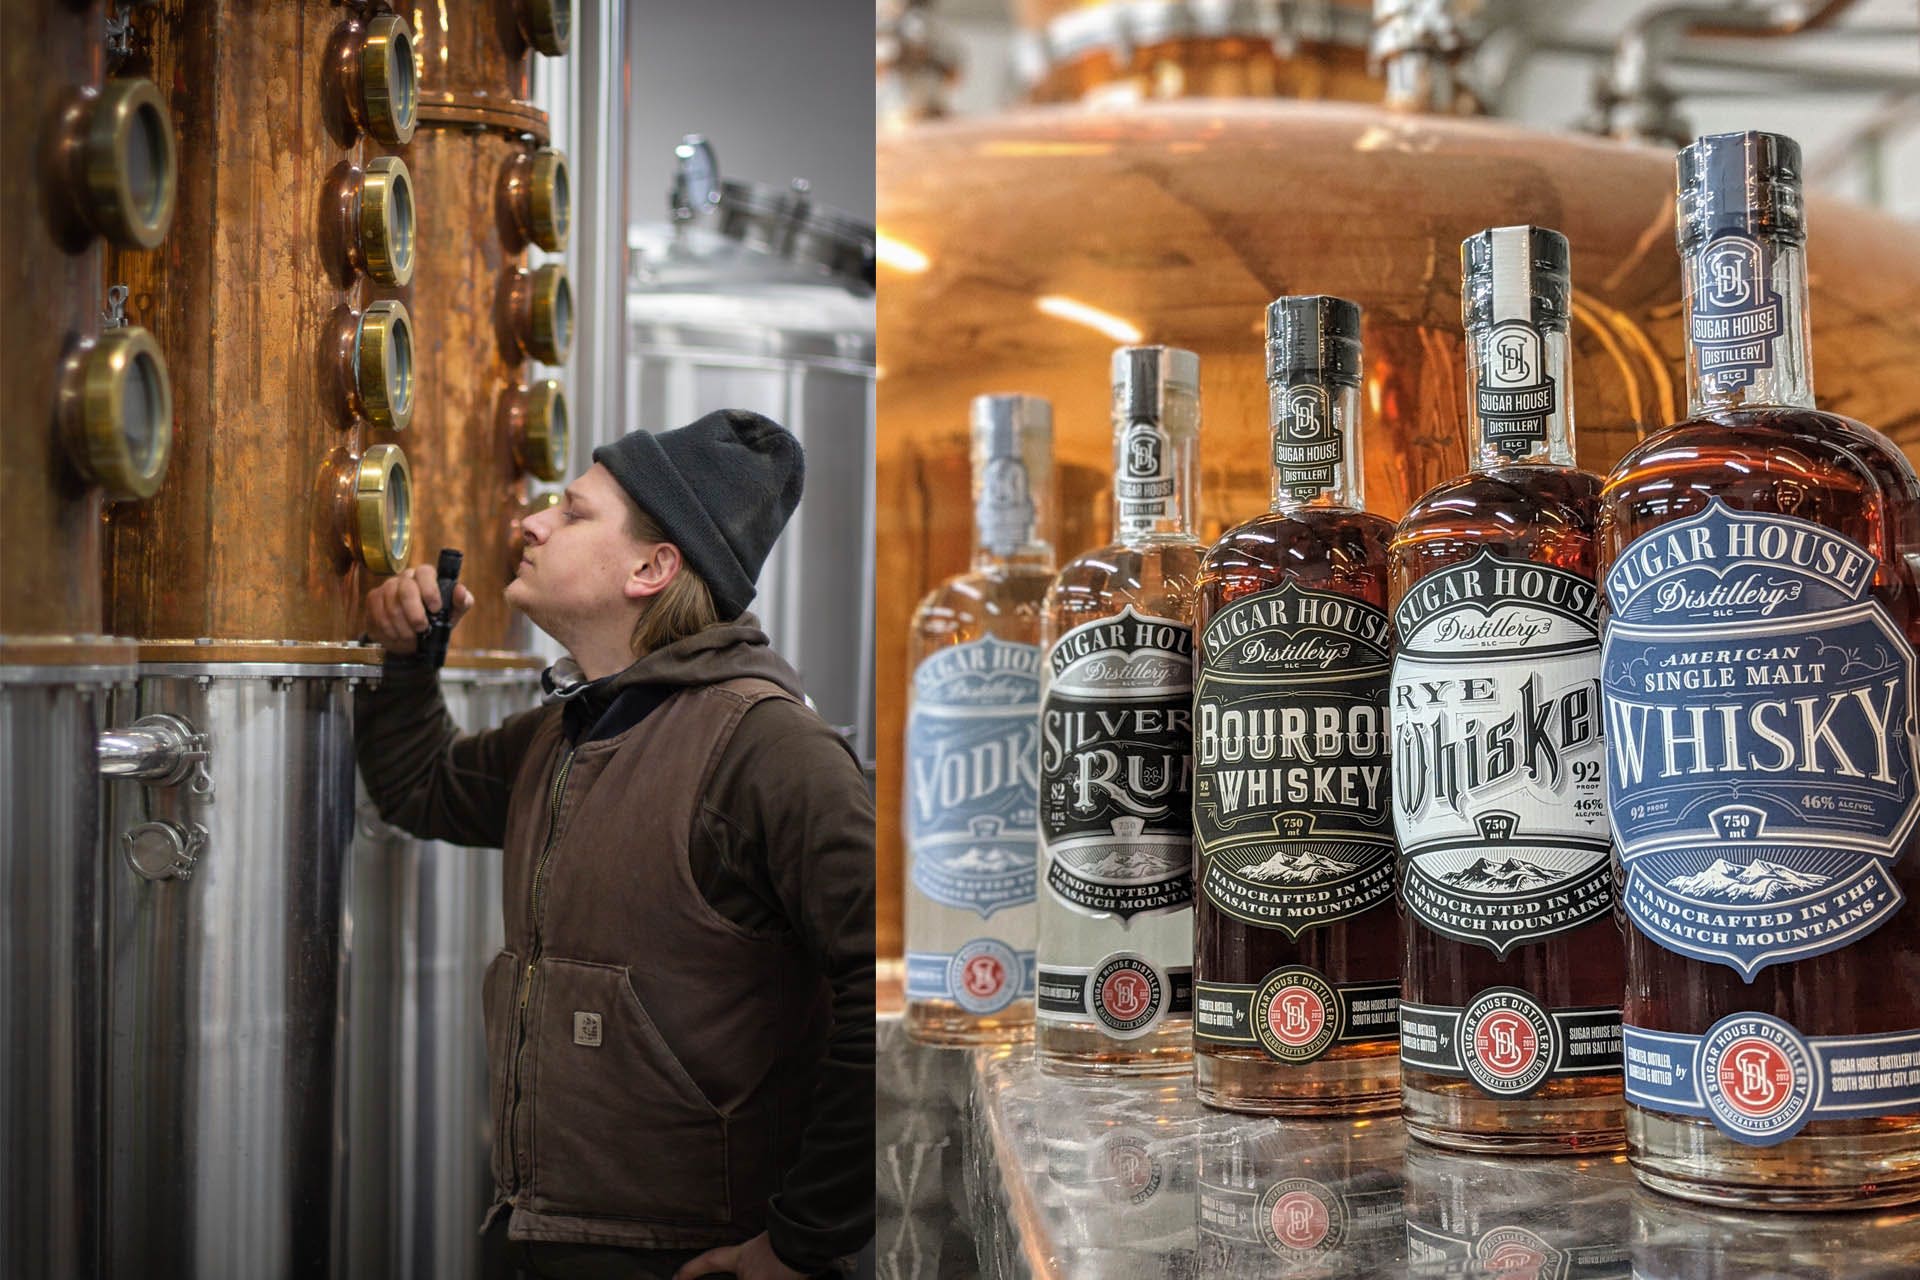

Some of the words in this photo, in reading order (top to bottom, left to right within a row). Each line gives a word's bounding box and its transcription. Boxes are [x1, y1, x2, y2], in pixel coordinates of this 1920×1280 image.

[1695, 319, 1729, 339] SUGAR
[1733, 311, 1773, 336] HOUSE
[1705, 345, 1761, 365] DISTILLERY
[1481, 393, 1512, 412] SUGAR
[1515, 390, 1549, 411] HOUSE
[1490, 419, 1539, 434] DISTILLERY
[1278, 445, 1304, 462] SUGAR
[1306, 442, 1337, 462] HOUSE
[1285, 468, 1328, 482] DISTILLERY
[1612, 527, 1715, 604] SUGAR
[1725, 524, 1864, 588] HOUSE
[1400, 570, 1484, 635] SUGAR
[1653, 574, 1802, 615] Distillery
[1712, 609, 1734, 617] SLC
[1207, 600, 1289, 657] SUGAR
[1296, 599, 1389, 650] HOUSE
[1434, 611, 1552, 646] Distillery
[1053, 625, 1126, 673] SUGAR
[1239, 637, 1351, 669] Distillery
[1659, 647, 1801, 667] AMERICAN
[1083, 659, 1180, 686] Distillery
[1645, 668, 1736, 692] SINGLE
[1746, 663, 1826, 686] MALT
[1396, 677, 1496, 710] RYE
[1043, 709, 1193, 772] SILVER
[1606, 678, 1899, 790] WHISKY
[912, 721, 1041, 821] VODK
[1572, 760, 1601, 783] 92
[1051, 783, 1065, 800] 82
[1200, 780, 1209, 791] 92
[1217, 766, 1383, 815] WHISKEY
[1574, 798, 1603, 810] 46%
[1631, 805, 1645, 821] 92
[1646, 802, 1669, 812] PROOF
[1801, 794, 1835, 810] 46%
[1838, 800, 1876, 812] ALC/VOL.
[1283, 818, 1304, 828] 750
[1485, 819, 1508, 830] 750
[1723, 814, 1751, 828] 750
[1052, 865, 1160, 897] HANDCRAFTED
[1164, 879, 1182, 892] IN
[1054, 880, 1115, 908] WASATCH
[1211, 867, 1330, 904] HANDCRAFTED
[1336, 884, 1356, 898] IN
[1359, 862, 1394, 888] THE
[1411, 874, 1541, 916] HANDCRAFTED
[1546, 894, 1569, 910] IN
[1573, 871, 1612, 899] THE
[1213, 883, 1282, 917] WASATCH
[1287, 880, 1390, 917] MOUNTAINS
[1412, 894, 1487, 931] WASATCH
[1491, 891, 1610, 931] MOUNTAINS
[1634, 878, 1794, 928] HANDCRAFTED
[1802, 902, 1827, 920] IN
[1833, 874, 1878, 907] THE
[1638, 904, 1728, 945] WASATCH
[1735, 898, 1875, 946] MOUNTAINS
[1072, 990, 1080, 1001] by
[1095, 976, 1105, 1006] SUGAR
[1103, 961, 1129, 976] HOUSE
[1132, 961, 1160, 1005] DISTILLERY
[1235, 1009, 1246, 1022] by
[1259, 995, 1271, 1030] SUGAR
[1268, 976, 1299, 995] HOUSE
[1302, 977, 1335, 1028] DISTILLERY
[1352, 1000, 1370, 1012] SUGAR
[1370, 999, 1387, 1011] HOUSE
[1352, 1013, 1371, 1026] SOUTH
[1371, 1012, 1383, 1025] SALT
[1384, 1011, 1396, 1023] LAKE
[1465, 1018, 1477, 1057] SUGAR
[1474, 998, 1507, 1018] HOUSE
[1511, 999, 1549, 1058] DISTILLERY
[1439, 1033, 1450, 1048] by
[1569, 1026, 1591, 1040] SUGAR
[1591, 1025, 1611, 1039] HOUSE
[1570, 1042, 1591, 1056] SOUTH
[1592, 1041, 1607, 1054] SALT
[1706, 1047, 1720, 1092] SUGAR
[1716, 1024, 1756, 1047] HOUSE
[1761, 1026, 1807, 1095] DISTILLERY
[1472, 1061, 1517, 1087] HANDCRAFTED
[1519, 1062, 1543, 1085] SPIRITS
[1675, 1064, 1687, 1080] by
[1830, 1058, 1855, 1074] SUGAR
[1856, 1056, 1879, 1072] HOUSE
[1879, 1053, 1912, 1070] DISTILLERY
[1776, 1073, 1790, 1081] 2013
[1832, 1076, 1857, 1092] SOUTH
[1858, 1075, 1875, 1090] SALT
[1875, 1073, 1893, 1089] LAKE
[1893, 1071, 1909, 1087] CITY,
[1716, 1097, 1770, 1127] HANDCRAFTED
[1773, 1099, 1801, 1125] SPIRITS
